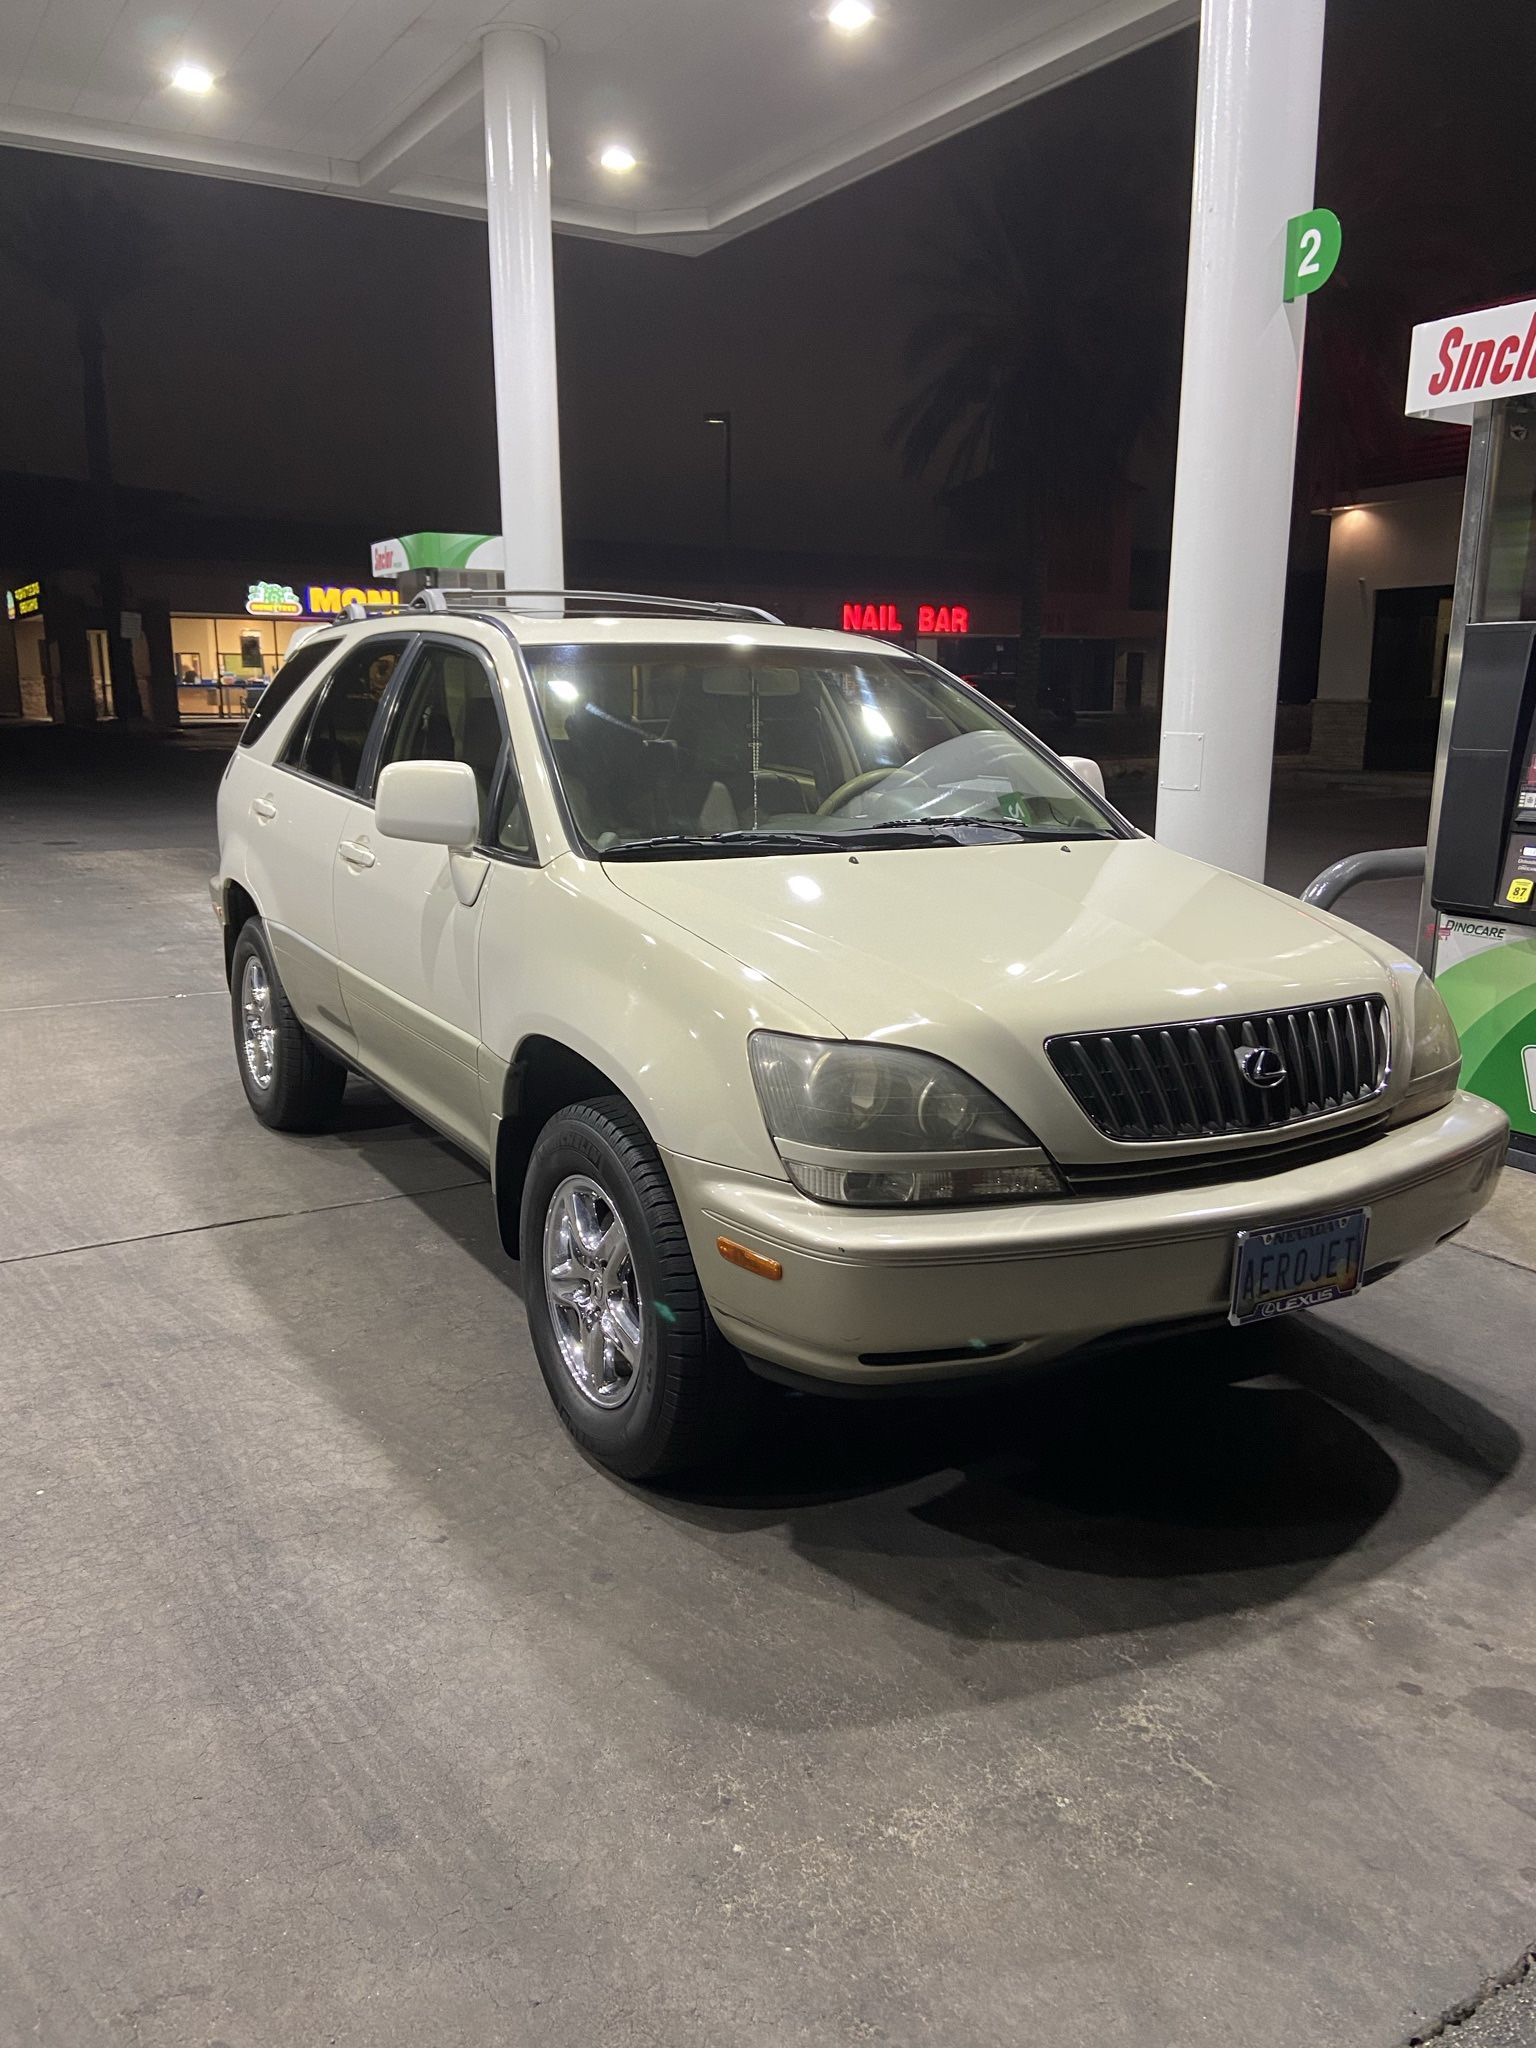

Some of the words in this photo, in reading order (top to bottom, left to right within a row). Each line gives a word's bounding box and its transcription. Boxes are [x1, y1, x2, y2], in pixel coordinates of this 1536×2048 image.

[1298, 229, 1321, 277] 2
[843, 604, 902, 630] NAIL
[918, 605, 968, 632] BAR
[1513, 887, 1527, 897] 87
[1447, 920, 1506, 938] DINOCARE
[1243, 1237, 1356, 1299] AEROJET
[1276, 1289, 1333, 1312] LEXUS
